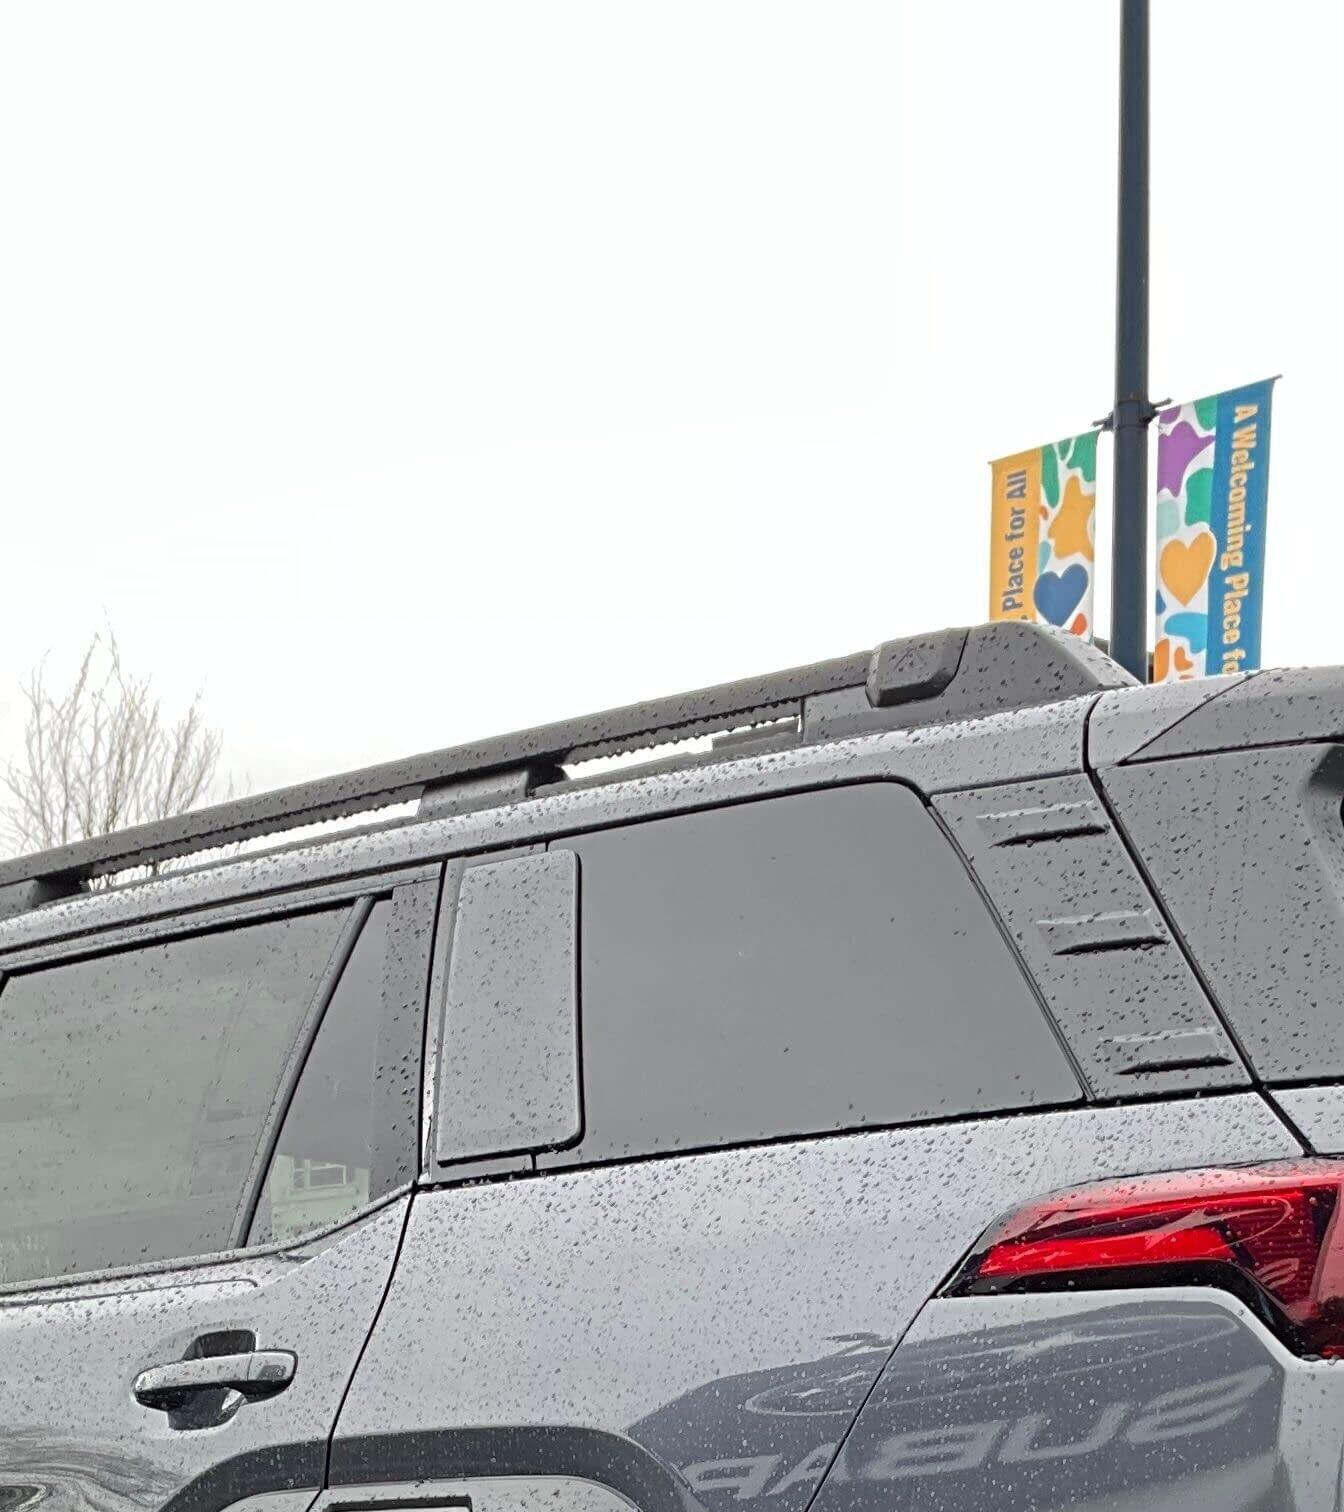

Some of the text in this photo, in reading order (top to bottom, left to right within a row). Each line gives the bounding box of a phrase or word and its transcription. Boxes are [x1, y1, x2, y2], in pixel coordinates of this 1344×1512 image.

[1002, 469, 1027, 612] Place for All
[1220, 404, 1258, 674] A Welcoming Place fo
